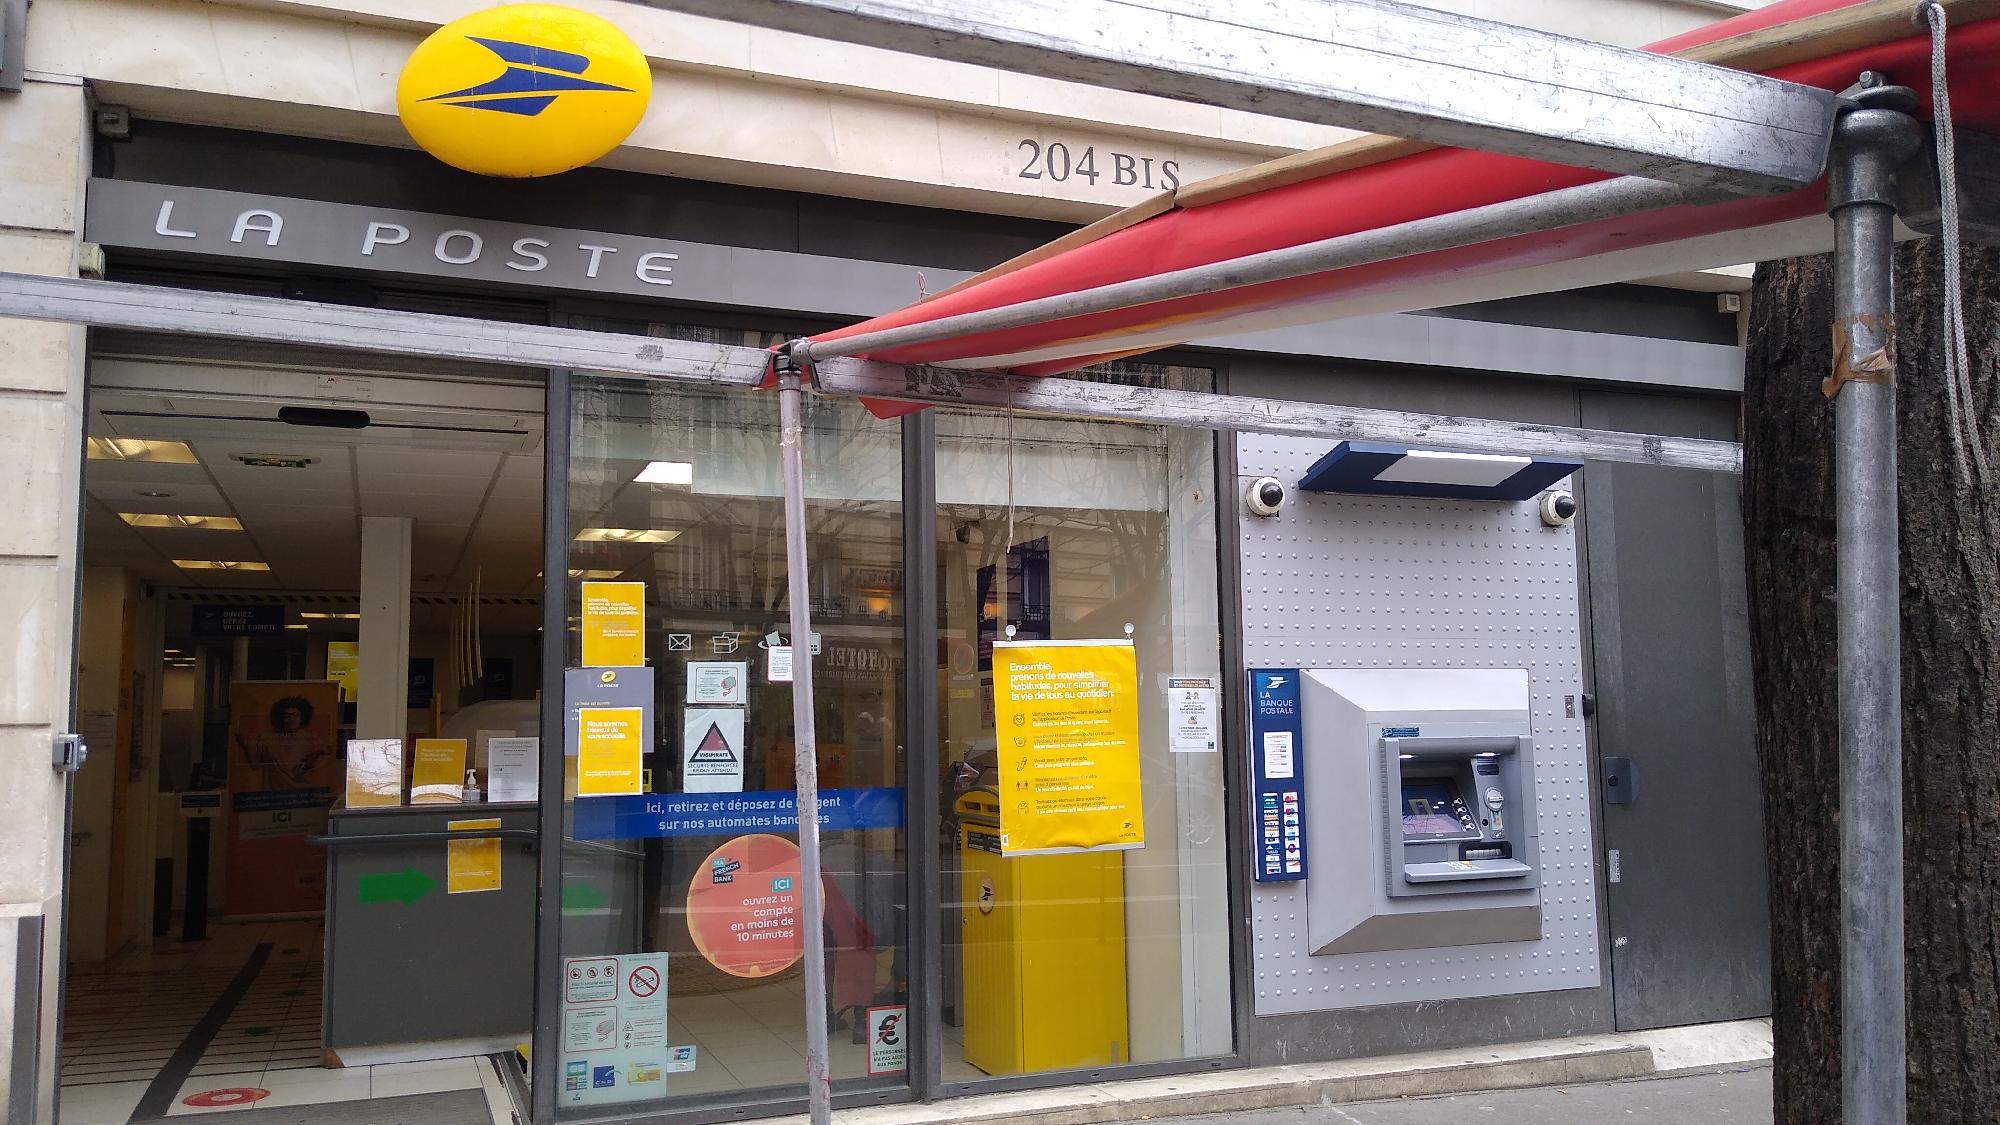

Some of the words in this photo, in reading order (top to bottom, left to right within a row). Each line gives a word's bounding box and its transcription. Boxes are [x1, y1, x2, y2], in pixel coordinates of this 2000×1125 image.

[1018, 138, 1100, 186] 204
[1110, 152, 1180, 191] BIS
[155, 200, 284, 246] LA
[361, 221, 680, 285] POSTE
[1009, 662, 1053, 672] Ensemble,
[1010, 673, 1044, 682] prenons
[1046, 671, 1056, 680] de
[1057, 670, 1095, 680] nouvelles
[1011, 680, 1053, 690] habitudes,
[1054, 682, 1072, 690] pour
[1074, 679, 1109, 690] simplifier
[1011, 692, 1019, 700] la
[1021, 692, 1033, 700] vie
[1035, 691, 1045, 700] de
[1047, 691, 1063, 699] tous
[1065, 691, 1075, 699] au
[1260, 691, 1271, 699] LA
[1260, 699, 1293, 707] BANQUE
[1260, 707, 1294, 715] POSTALE
[646, 802, 665, 814] Ici,
[668, 801, 709, 813] retirez
[712, 802, 725, 811] et
[727, 799, 775, 812] déposez
[778, 798, 793, 809] de
[271, 812, 292, 824] ICI
[659, 819, 680, 830] sur
[682, 819, 705, 829] nos
[707, 815, 771, 828] automates
[773, 814, 830, 826] bances
[714, 862, 739, 876] FRENCH
[714, 875, 732, 883] BANK
[774, 879, 790, 890] ICI
[742, 895, 777, 906] ouvrez
[780, 894, 793, 903] un
[753, 906, 793, 917] compte
[730, 922, 744, 931] en
[747, 918, 779, 930] moins
[780, 917, 794, 926] de
[736, 932, 750, 942] 10
[752, 929, 794, 941] minutes
